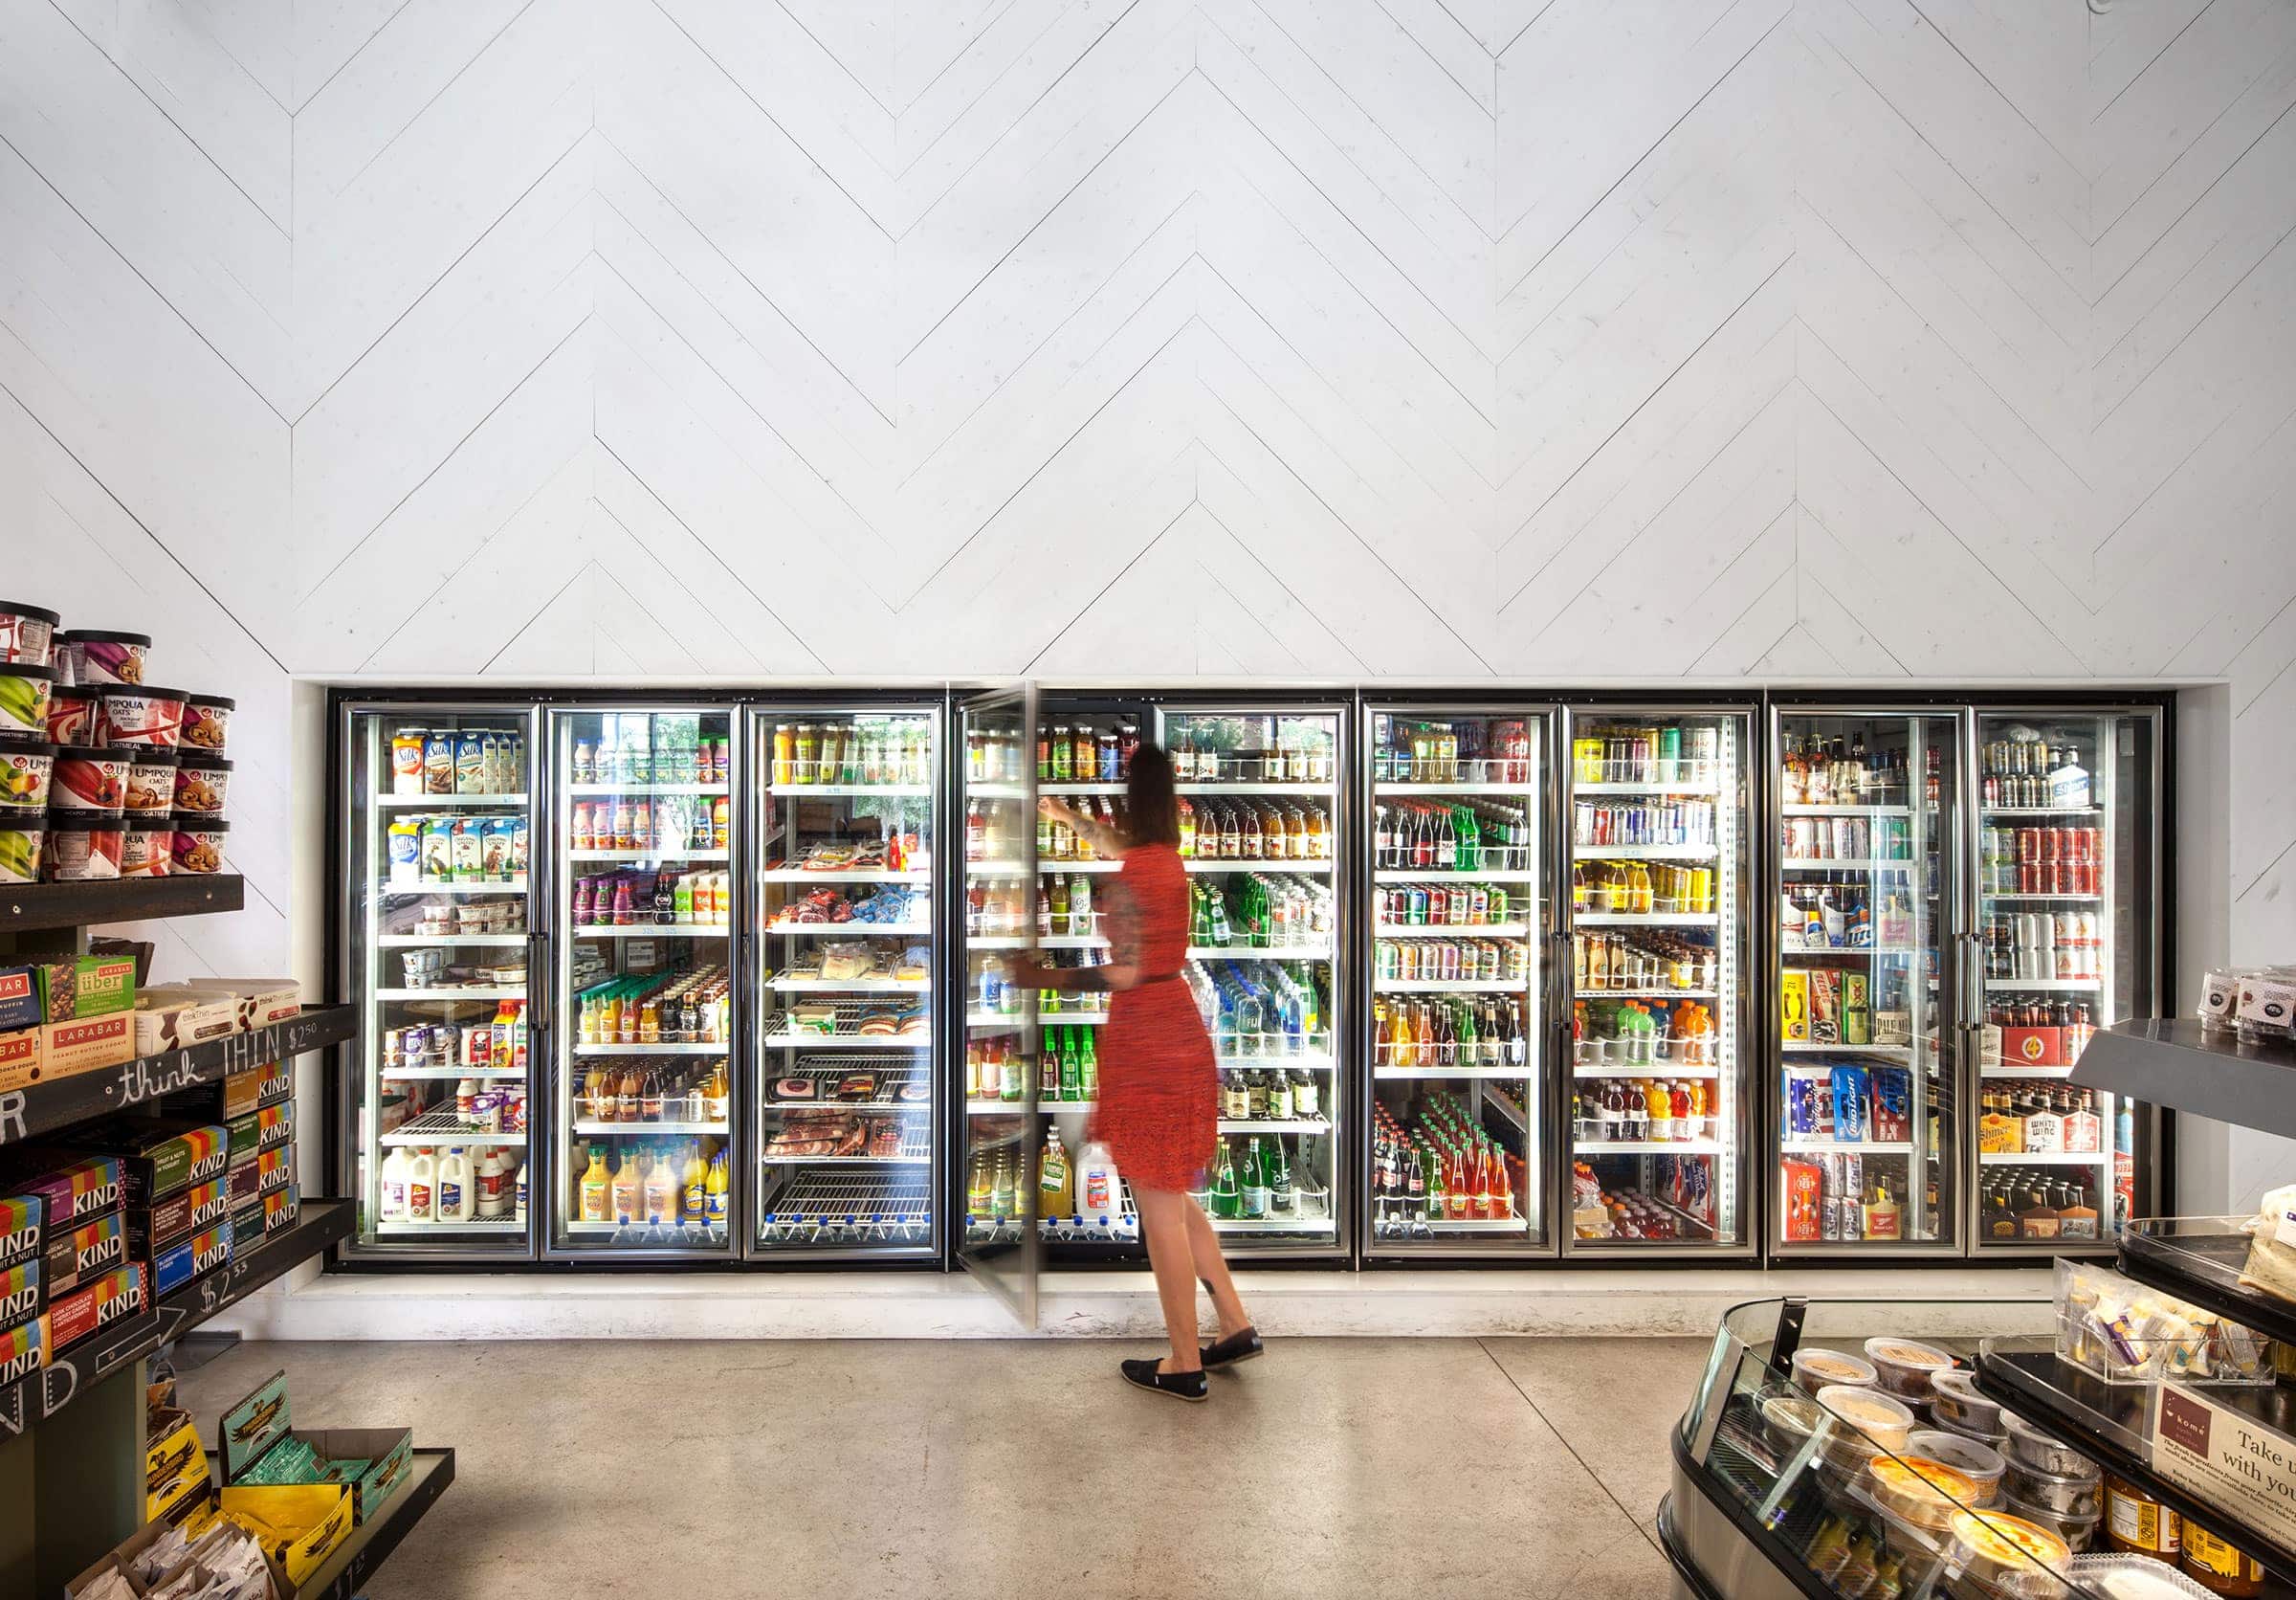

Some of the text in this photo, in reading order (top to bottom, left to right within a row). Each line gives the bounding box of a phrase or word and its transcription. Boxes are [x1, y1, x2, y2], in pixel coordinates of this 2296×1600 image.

[428, 744, 448, 758] Silk
[459, 744, 480, 758] Silk
[82, 973, 121, 991] über
[57, 1021, 122, 1042] LARABAR
[117, 1050, 206, 1108] think
[219, 1025, 281, 1076] THIN
[258, 1075, 291, 1099] KIND
[260, 1121, 292, 1145] KIND
[190, 1151, 226, 1181] KIND
[259, 1166, 291, 1191] KIND
[74, 1182, 120, 1216] KIND
[191, 1196, 227, 1228] KIND
[267, 1203, 298, 1232] KIND
[17, 1247, 35, 1261] NUT
[77, 1234, 122, 1272] KIND
[193, 1242, 228, 1276] KIND
[17, 1308, 33, 1322] NUT
[52, 1294, 93, 1319] DARK CHOCOLATE
[97, 1287, 141, 1325] KIND
[2238, 1430, 2283, 1466] Take
[2222, 1451, 2262, 1482] with
